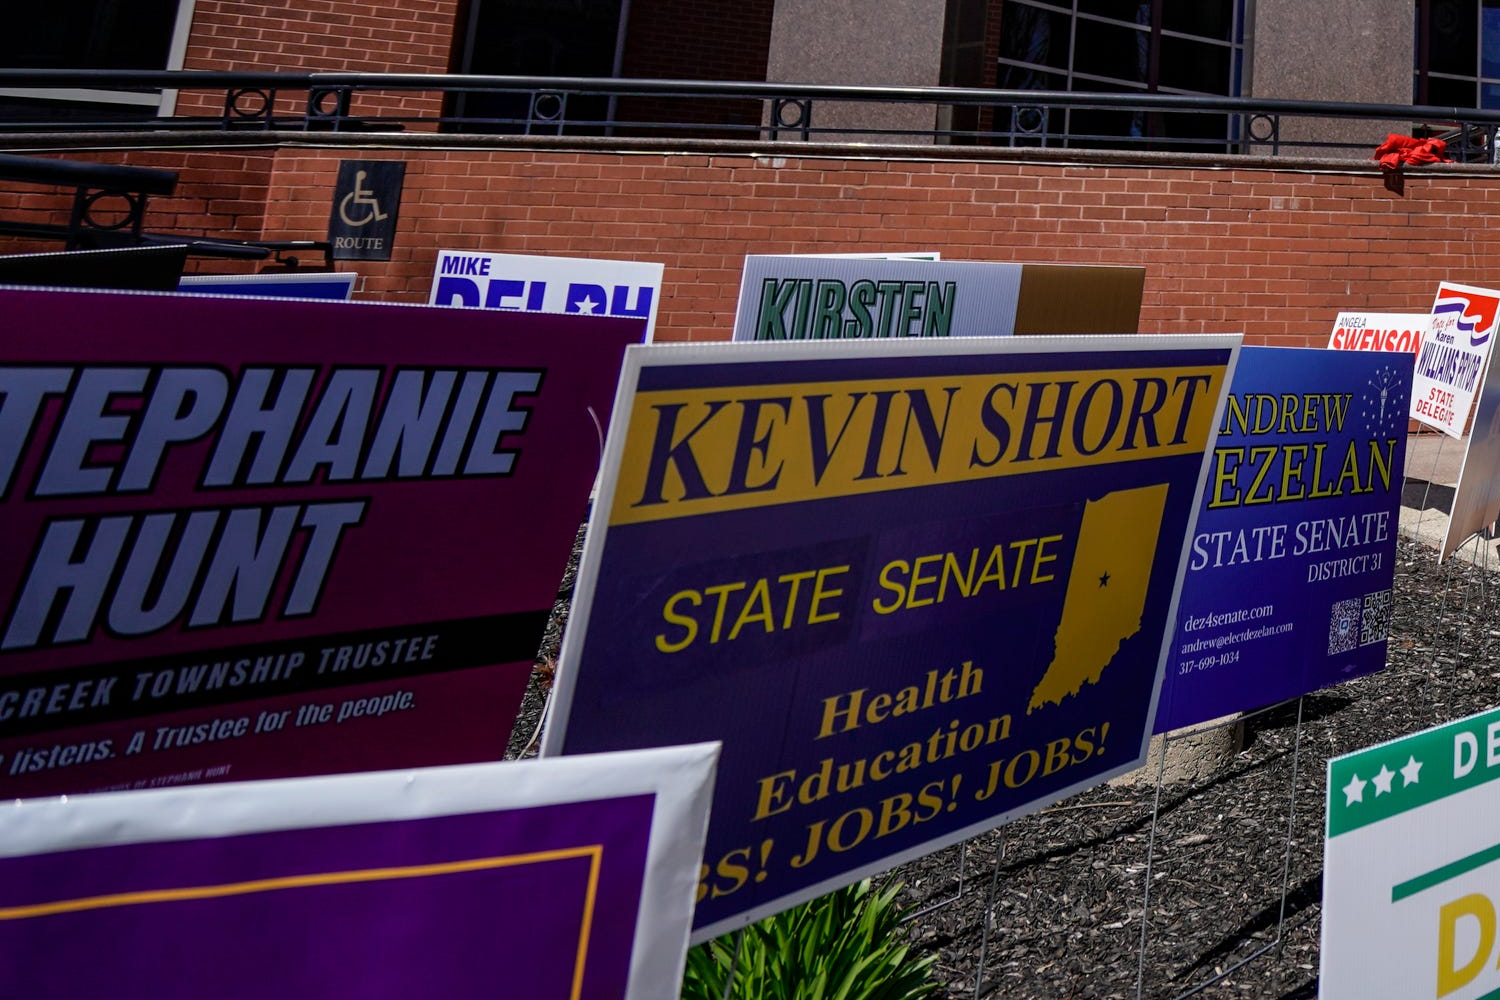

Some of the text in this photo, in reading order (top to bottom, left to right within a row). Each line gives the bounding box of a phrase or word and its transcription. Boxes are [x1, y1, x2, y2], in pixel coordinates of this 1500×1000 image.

[334, 236, 384, 252] ROUTE
[440, 255, 492, 277] MIKE
[754, 278, 957, 342] KIRSTEN
[1338, 316, 1367, 328] ANGELA
[1435, 330, 1455, 345] Karen
[1417, 341, 1482, 393] WILLIAMS PRYOR
[1217, 393, 1353, 436] NDREW
[1415, 399, 1455, 427] DELEGATE
[1429, 387, 1455, 408] STATE
[0, 367, 543, 498] TEPHANIE
[632, 374, 1213, 510] KEVIN SHORT
[1207, 440, 1398, 510] EZELAN
[1190, 511, 1390, 572] STATE SENATE
[1307, 552, 1383, 583] DISTRICT 31
[2, 500, 367, 651] HUNT
[655, 534, 1063, 655] STATE SENATE
[1181, 620, 1294, 654] andrew@electdezelan.com
[1184, 603, 1275, 633] dez4senate.com
[0, 634, 440, 722] CREEK TOWNSHIP TRUSTEE
[1178, 651, 1240, 675] 317-699-1034
[816, 660, 985, 741] Health
[9, 739, 116, 776] listens.
[126, 730, 145, 756] A
[153, 716, 249, 751] Trustee
[255, 708, 291, 733] for
[295, 700, 336, 727] the
[337, 689, 416, 724] people.
[750, 712, 1013, 823] Education
[790, 773, 963, 869] JOBS!
[975, 723, 1111, 800] JOBS!
